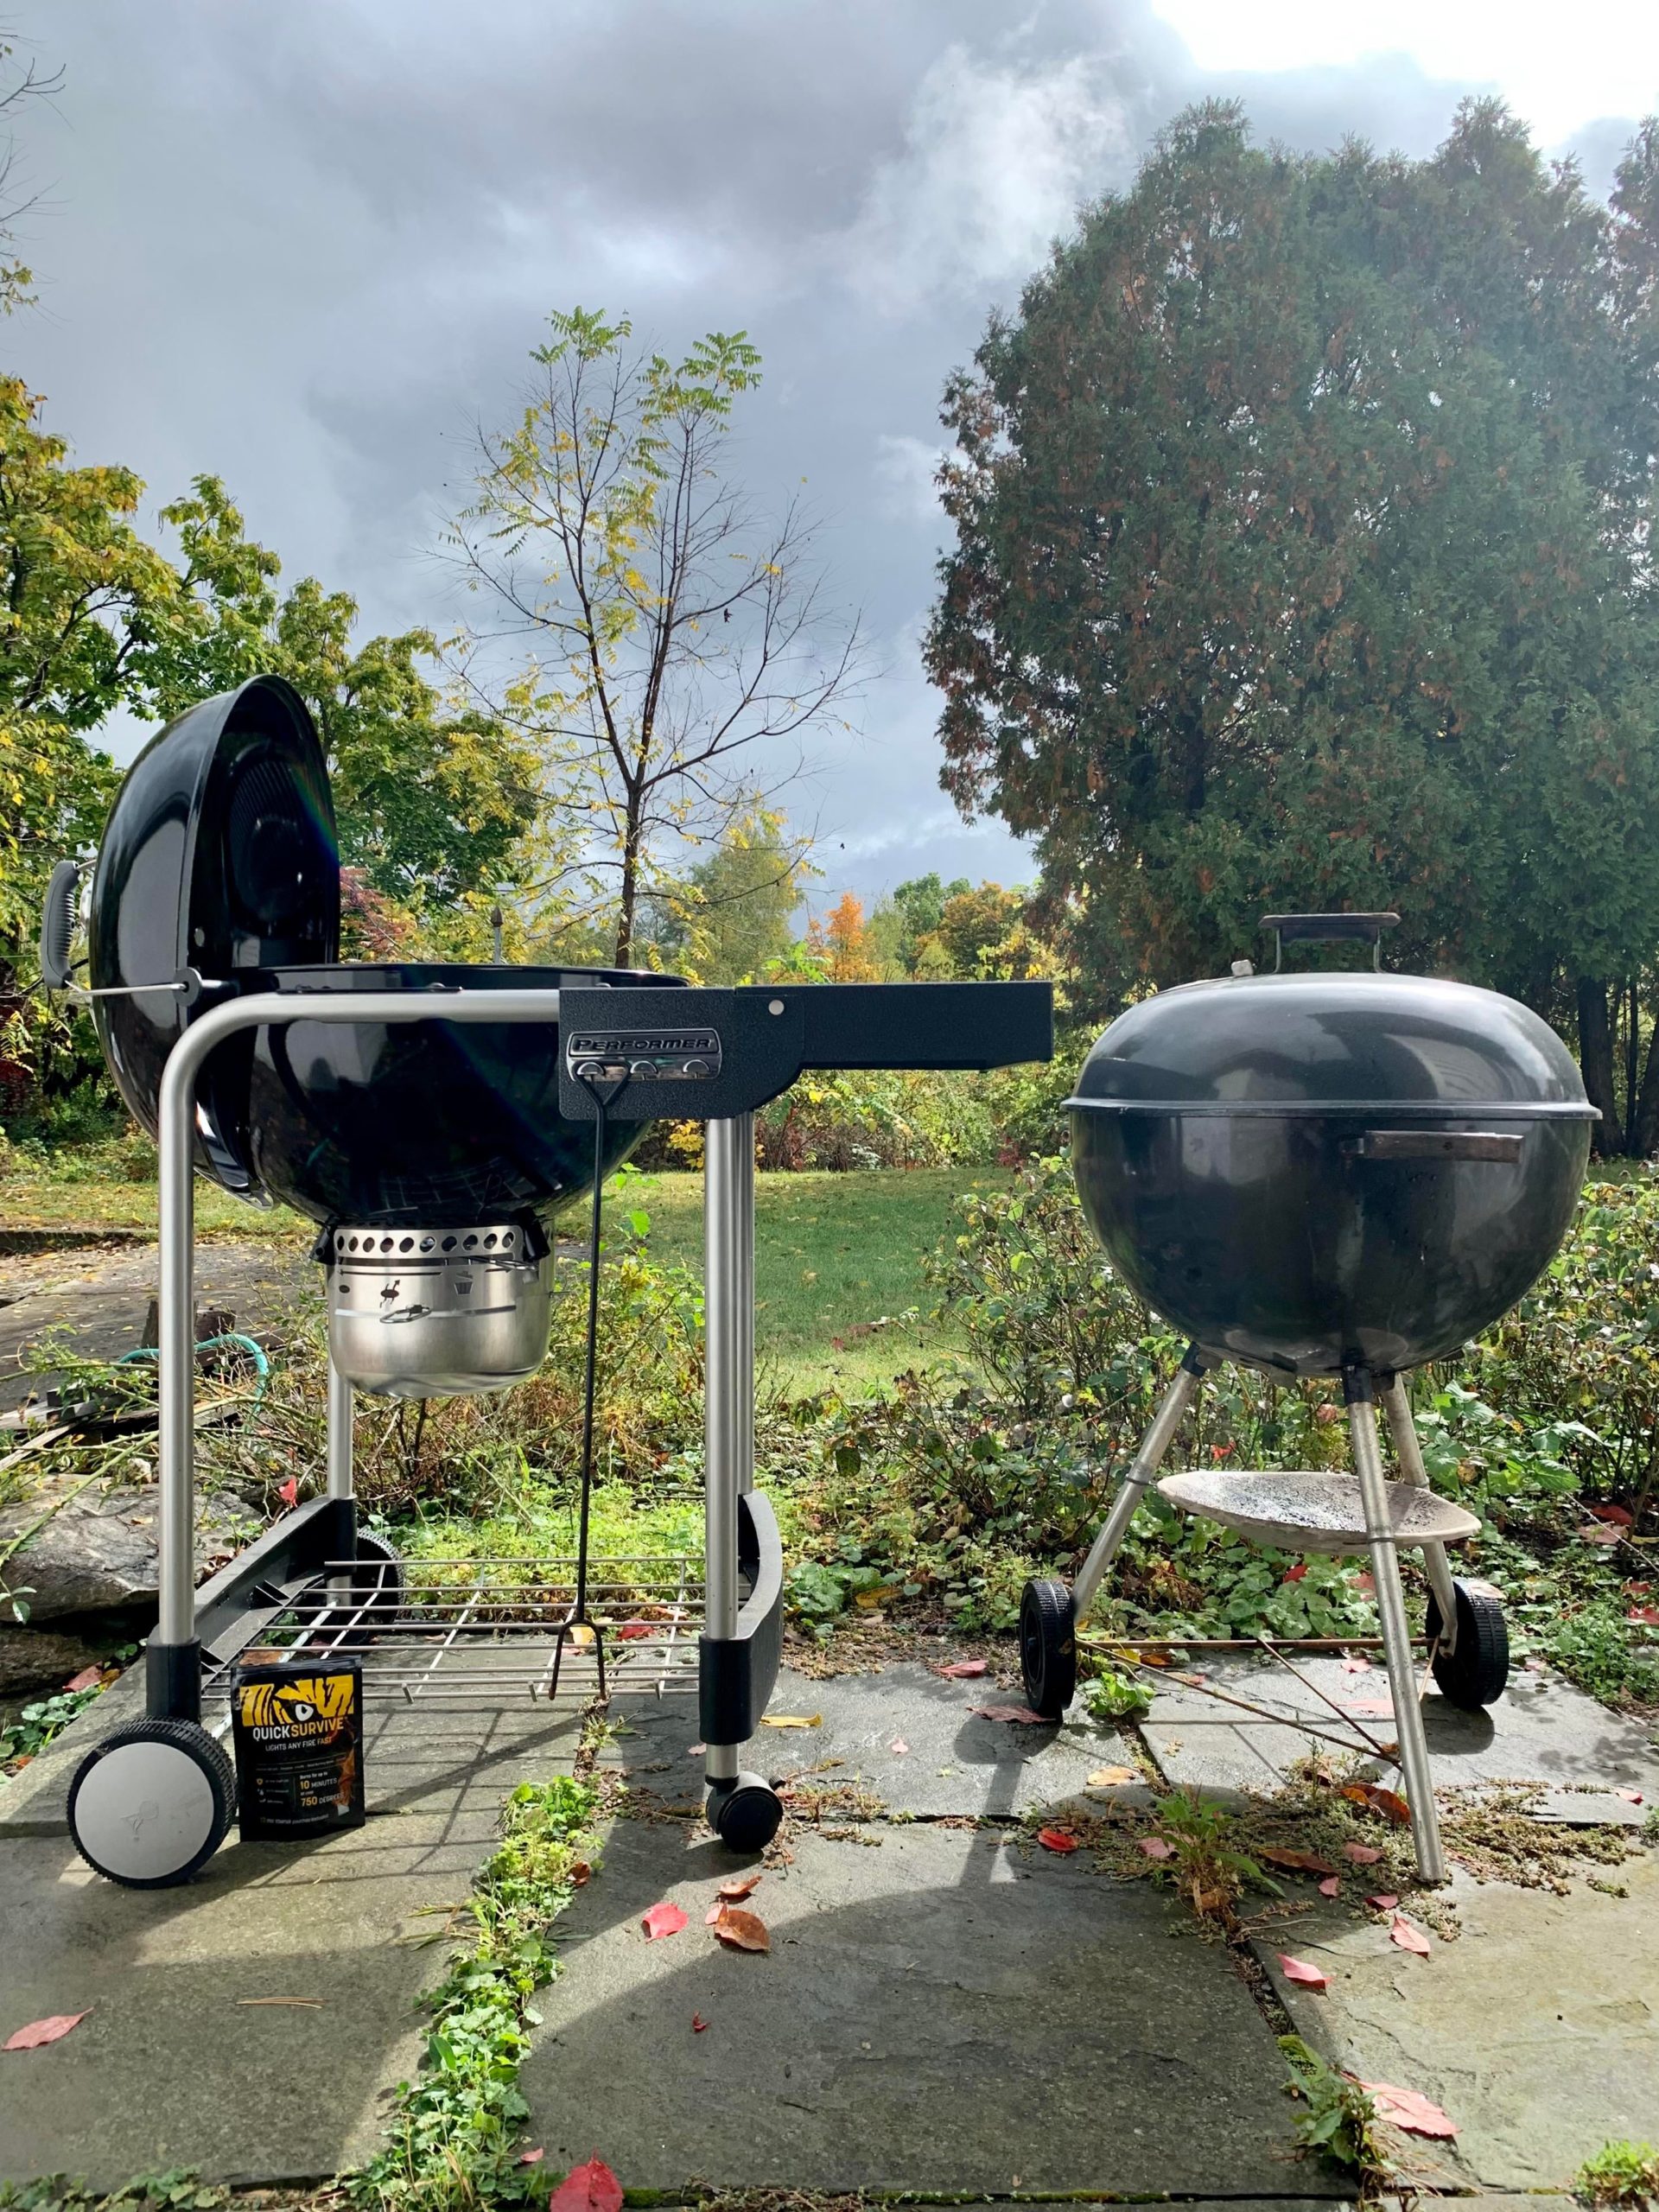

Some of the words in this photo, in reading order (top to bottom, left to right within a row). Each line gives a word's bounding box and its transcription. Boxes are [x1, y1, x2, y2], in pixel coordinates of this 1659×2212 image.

[575, 1039, 712, 1051] PERFORMER
[252, 1717, 344, 1742] QUICKSURVIVE
[265, 1743, 287, 1751] LIGHTS
[288, 1741, 302, 1750] ANY
[302, 1738, 316, 1748] FIRE
[317, 1736, 333, 1745] FAST
[300, 1780, 310, 1790] 10
[311, 1777, 338, 1789] MINUTES
[300, 1796, 318, 1808] 750
[318, 1791, 344, 1805] DEGREES
